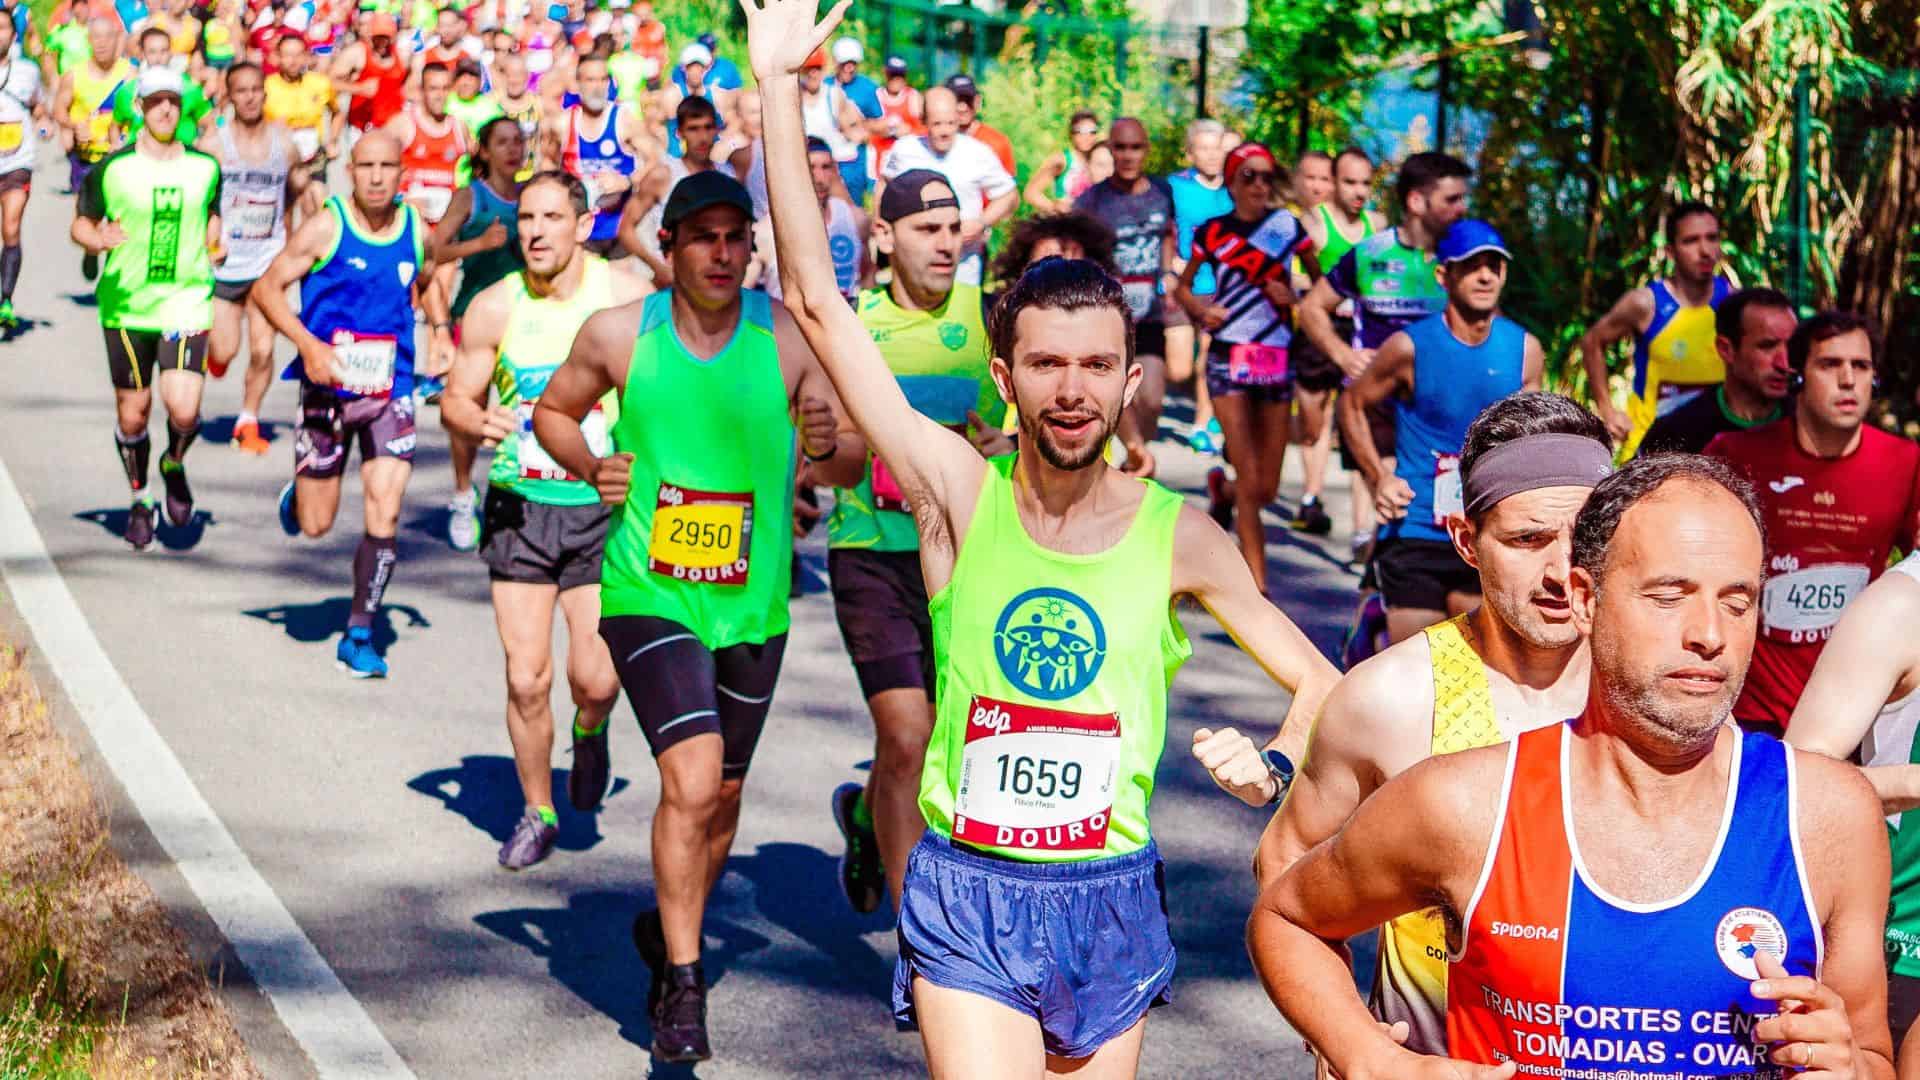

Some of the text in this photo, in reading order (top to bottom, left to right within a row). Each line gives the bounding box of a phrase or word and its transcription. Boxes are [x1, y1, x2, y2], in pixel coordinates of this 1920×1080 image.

[670, 518, 732, 549] 2950
[672, 558, 748, 581] DOURO
[1771, 553, 1799, 574] edp
[1786, 583, 1847, 609] 4265
[972, 704, 1011, 736] edp
[996, 753, 1083, 800] 1659
[996, 814, 1107, 847] DOURO
[1490, 921, 1560, 941] SPIDORA
[1481, 984, 1682, 1033] TRANSPORTES
[1512, 1029, 1667, 1064] TOMADIAS
[1692, 1043, 1769, 1066] OVAR
